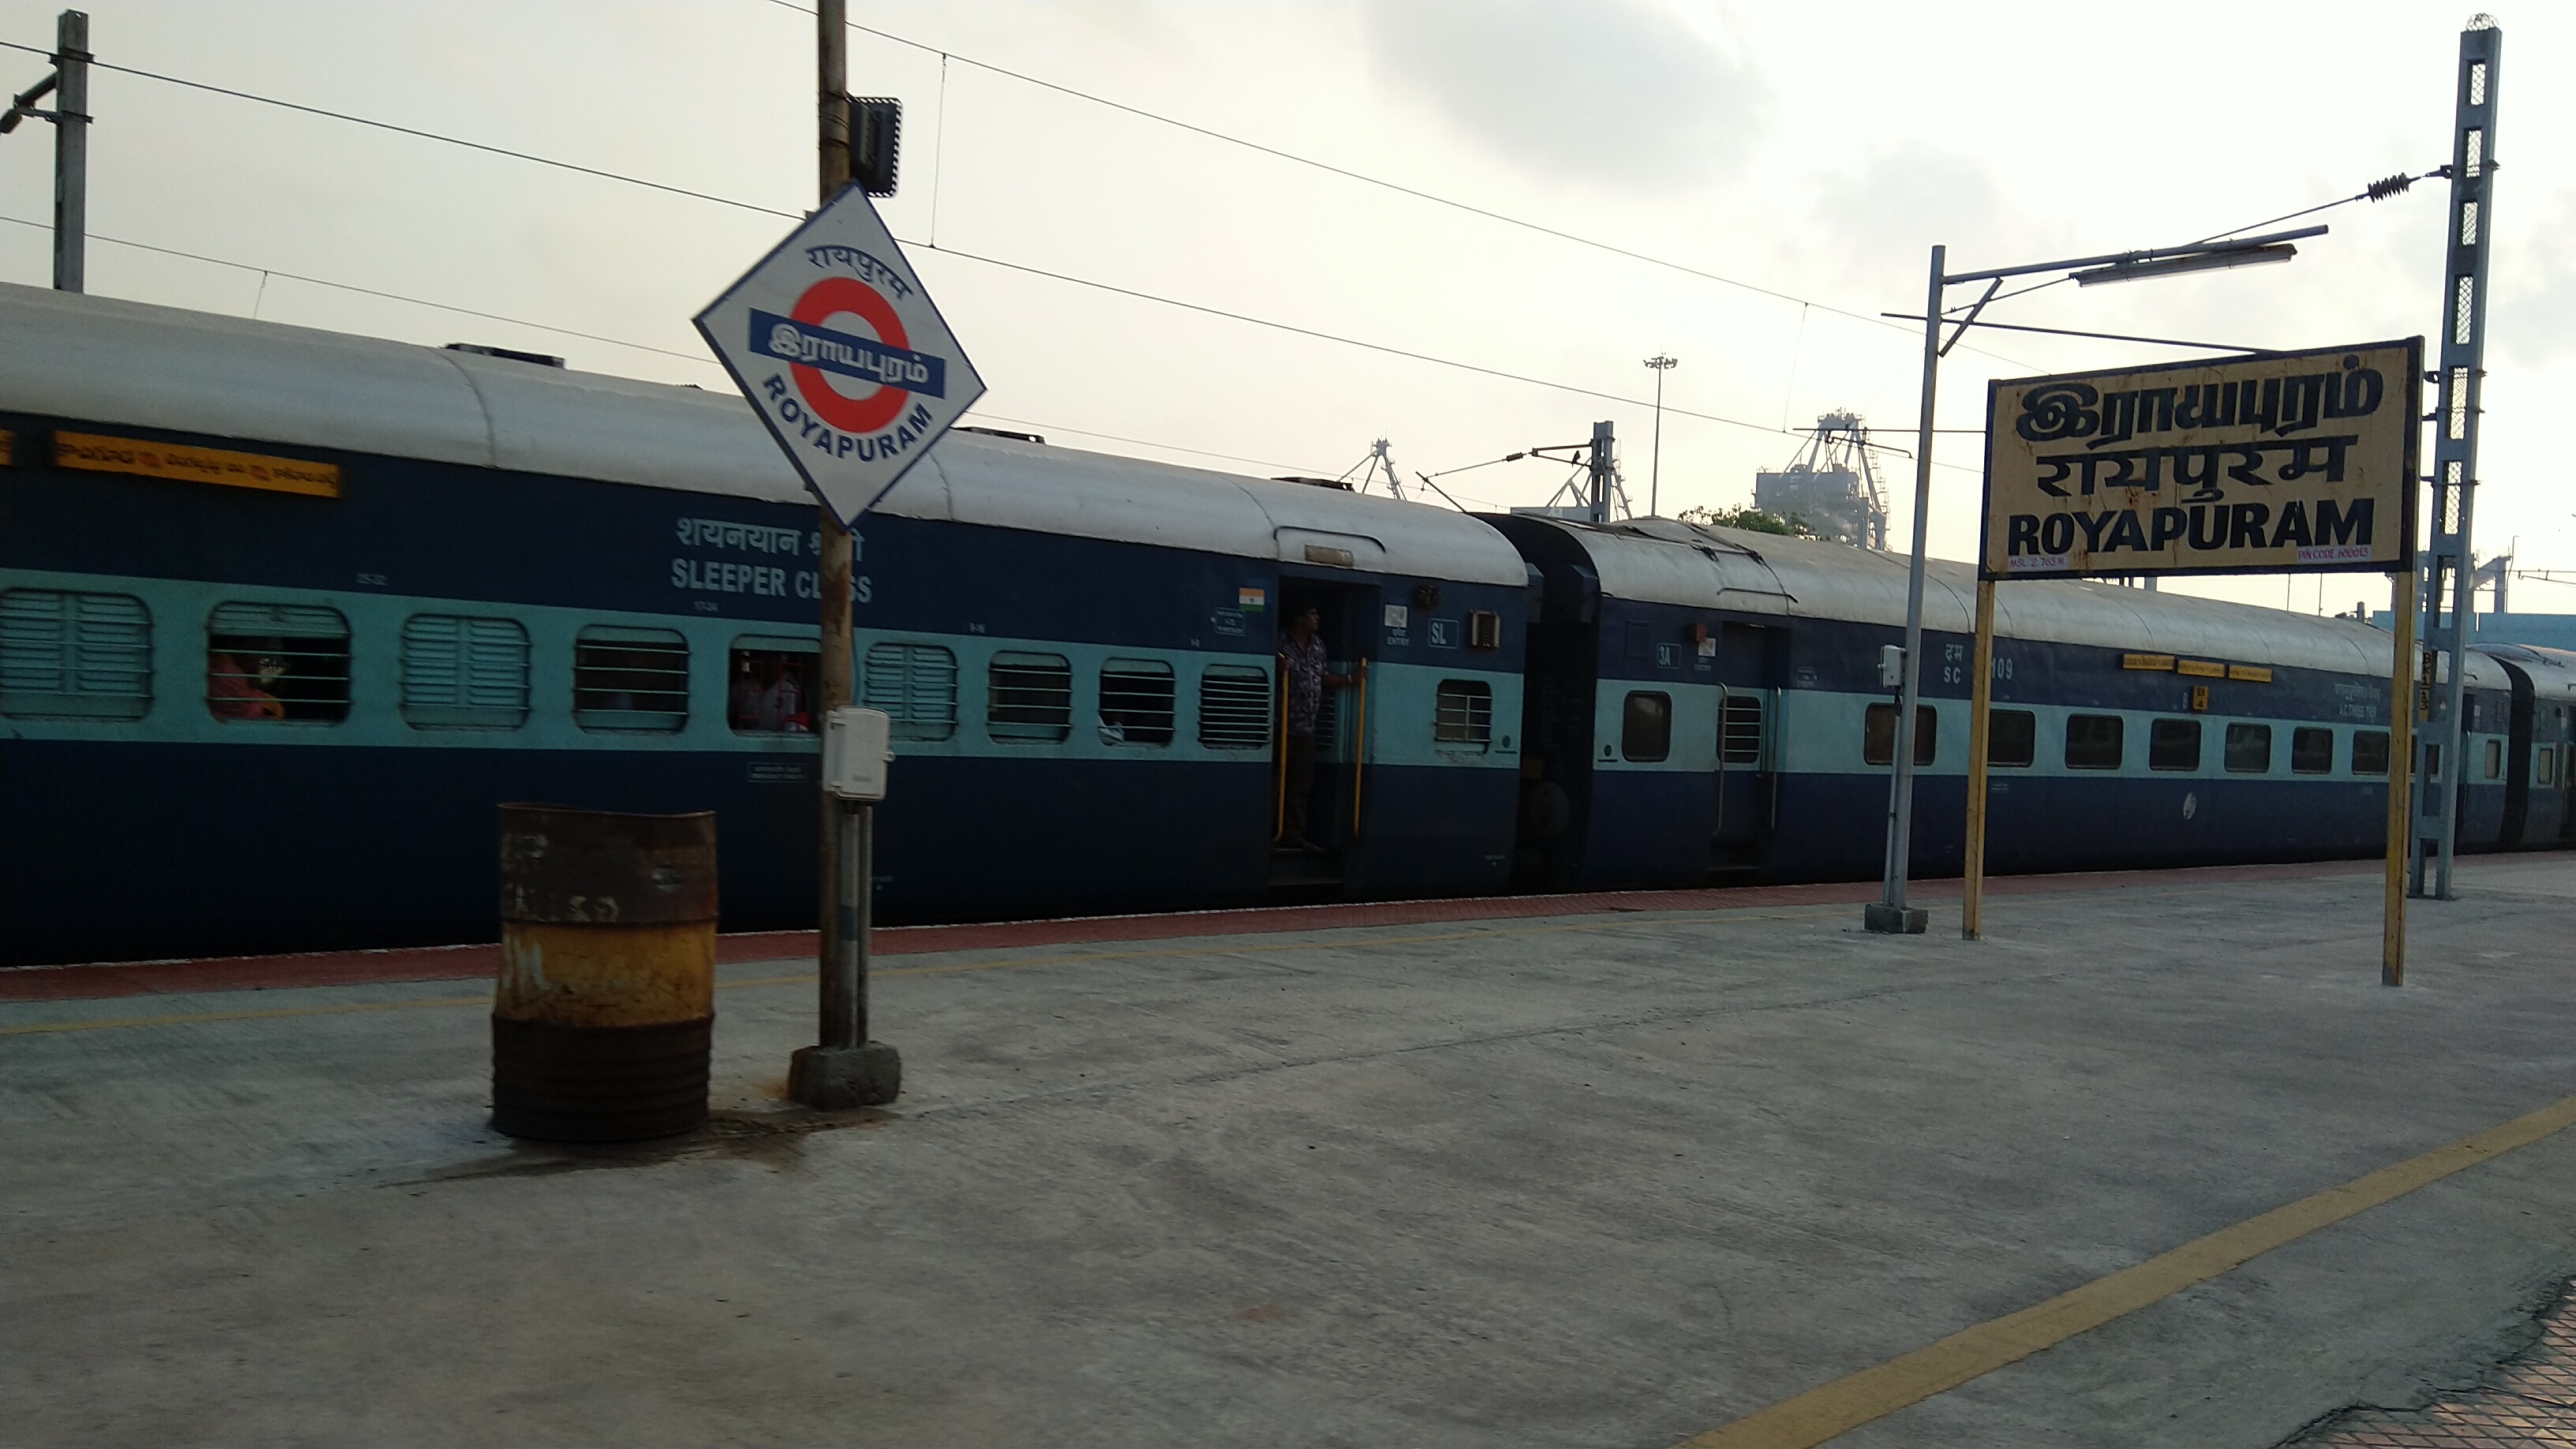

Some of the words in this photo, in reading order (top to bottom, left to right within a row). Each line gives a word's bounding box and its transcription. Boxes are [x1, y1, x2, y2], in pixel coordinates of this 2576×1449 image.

[804, 245, 914, 301] रायपुरम
[767, 322, 930, 384] இராயபுரம்
[762, 373, 934, 462] ROYAPURAM
[2016, 354, 2384, 451] இராயபுரம்
[2036, 434, 2359, 504] रायपुरम
[676, 517, 802, 556] शयनयान
[2008, 498, 2375, 556] ROYAPURAM
[671, 557, 787, 597] SLEEPER
[1431, 621, 1447, 645] SL
[1659, 646, 1671, 665] 3A
[1943, 666, 1961, 684] SC
